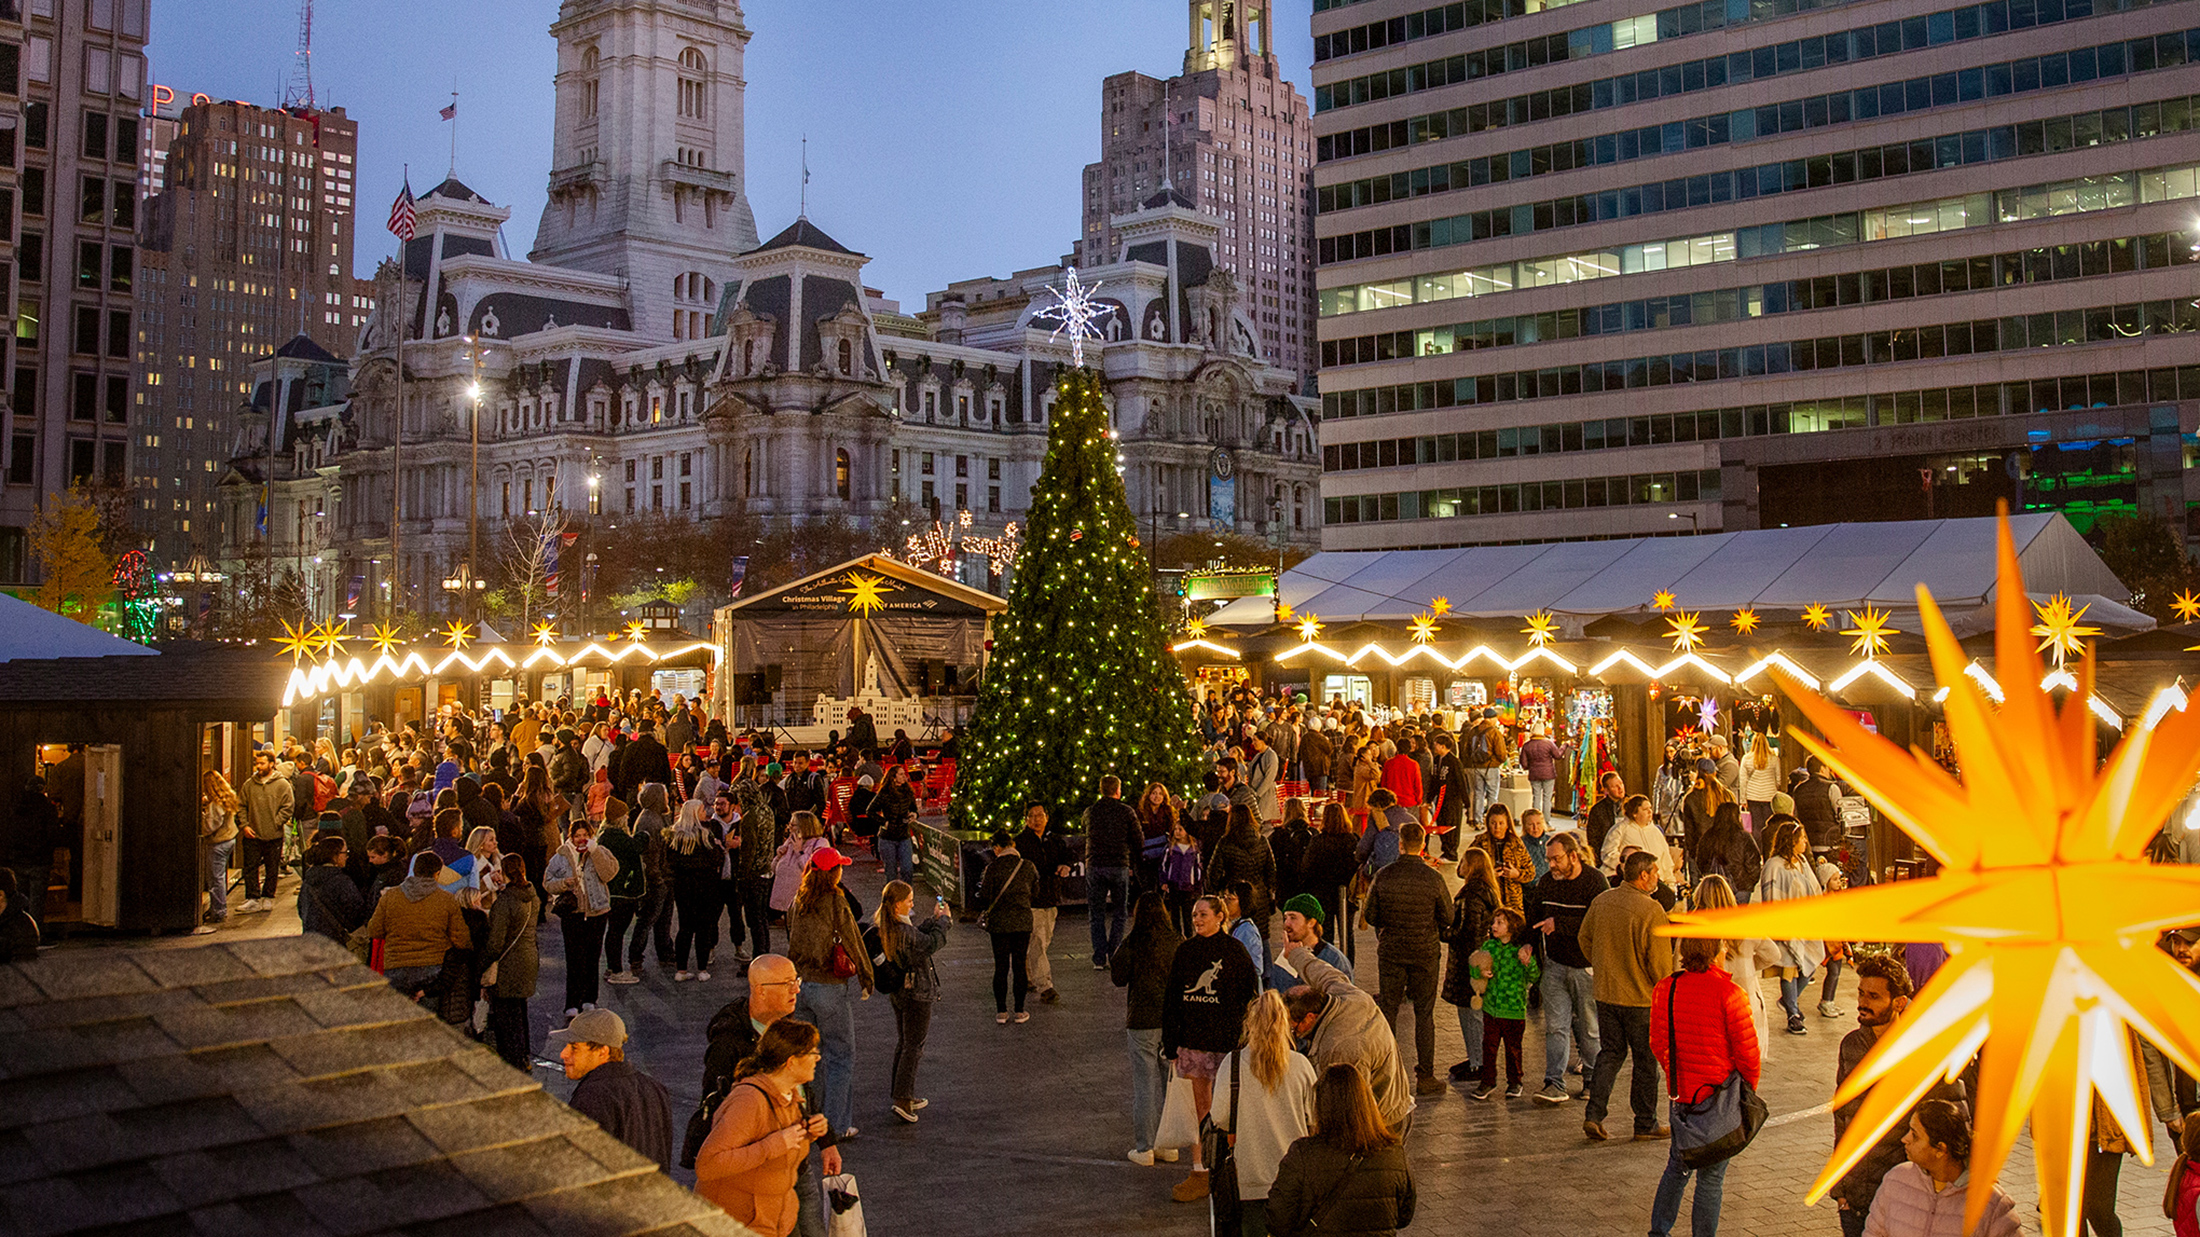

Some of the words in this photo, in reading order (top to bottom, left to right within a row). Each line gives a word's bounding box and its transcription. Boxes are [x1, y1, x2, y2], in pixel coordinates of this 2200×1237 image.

[782, 595, 820, 603] Christmas
[821, 595, 846, 604] Village
[799, 603, 838, 611] Philadelphia
[1183, 994, 1220, 1004] KANGOL
